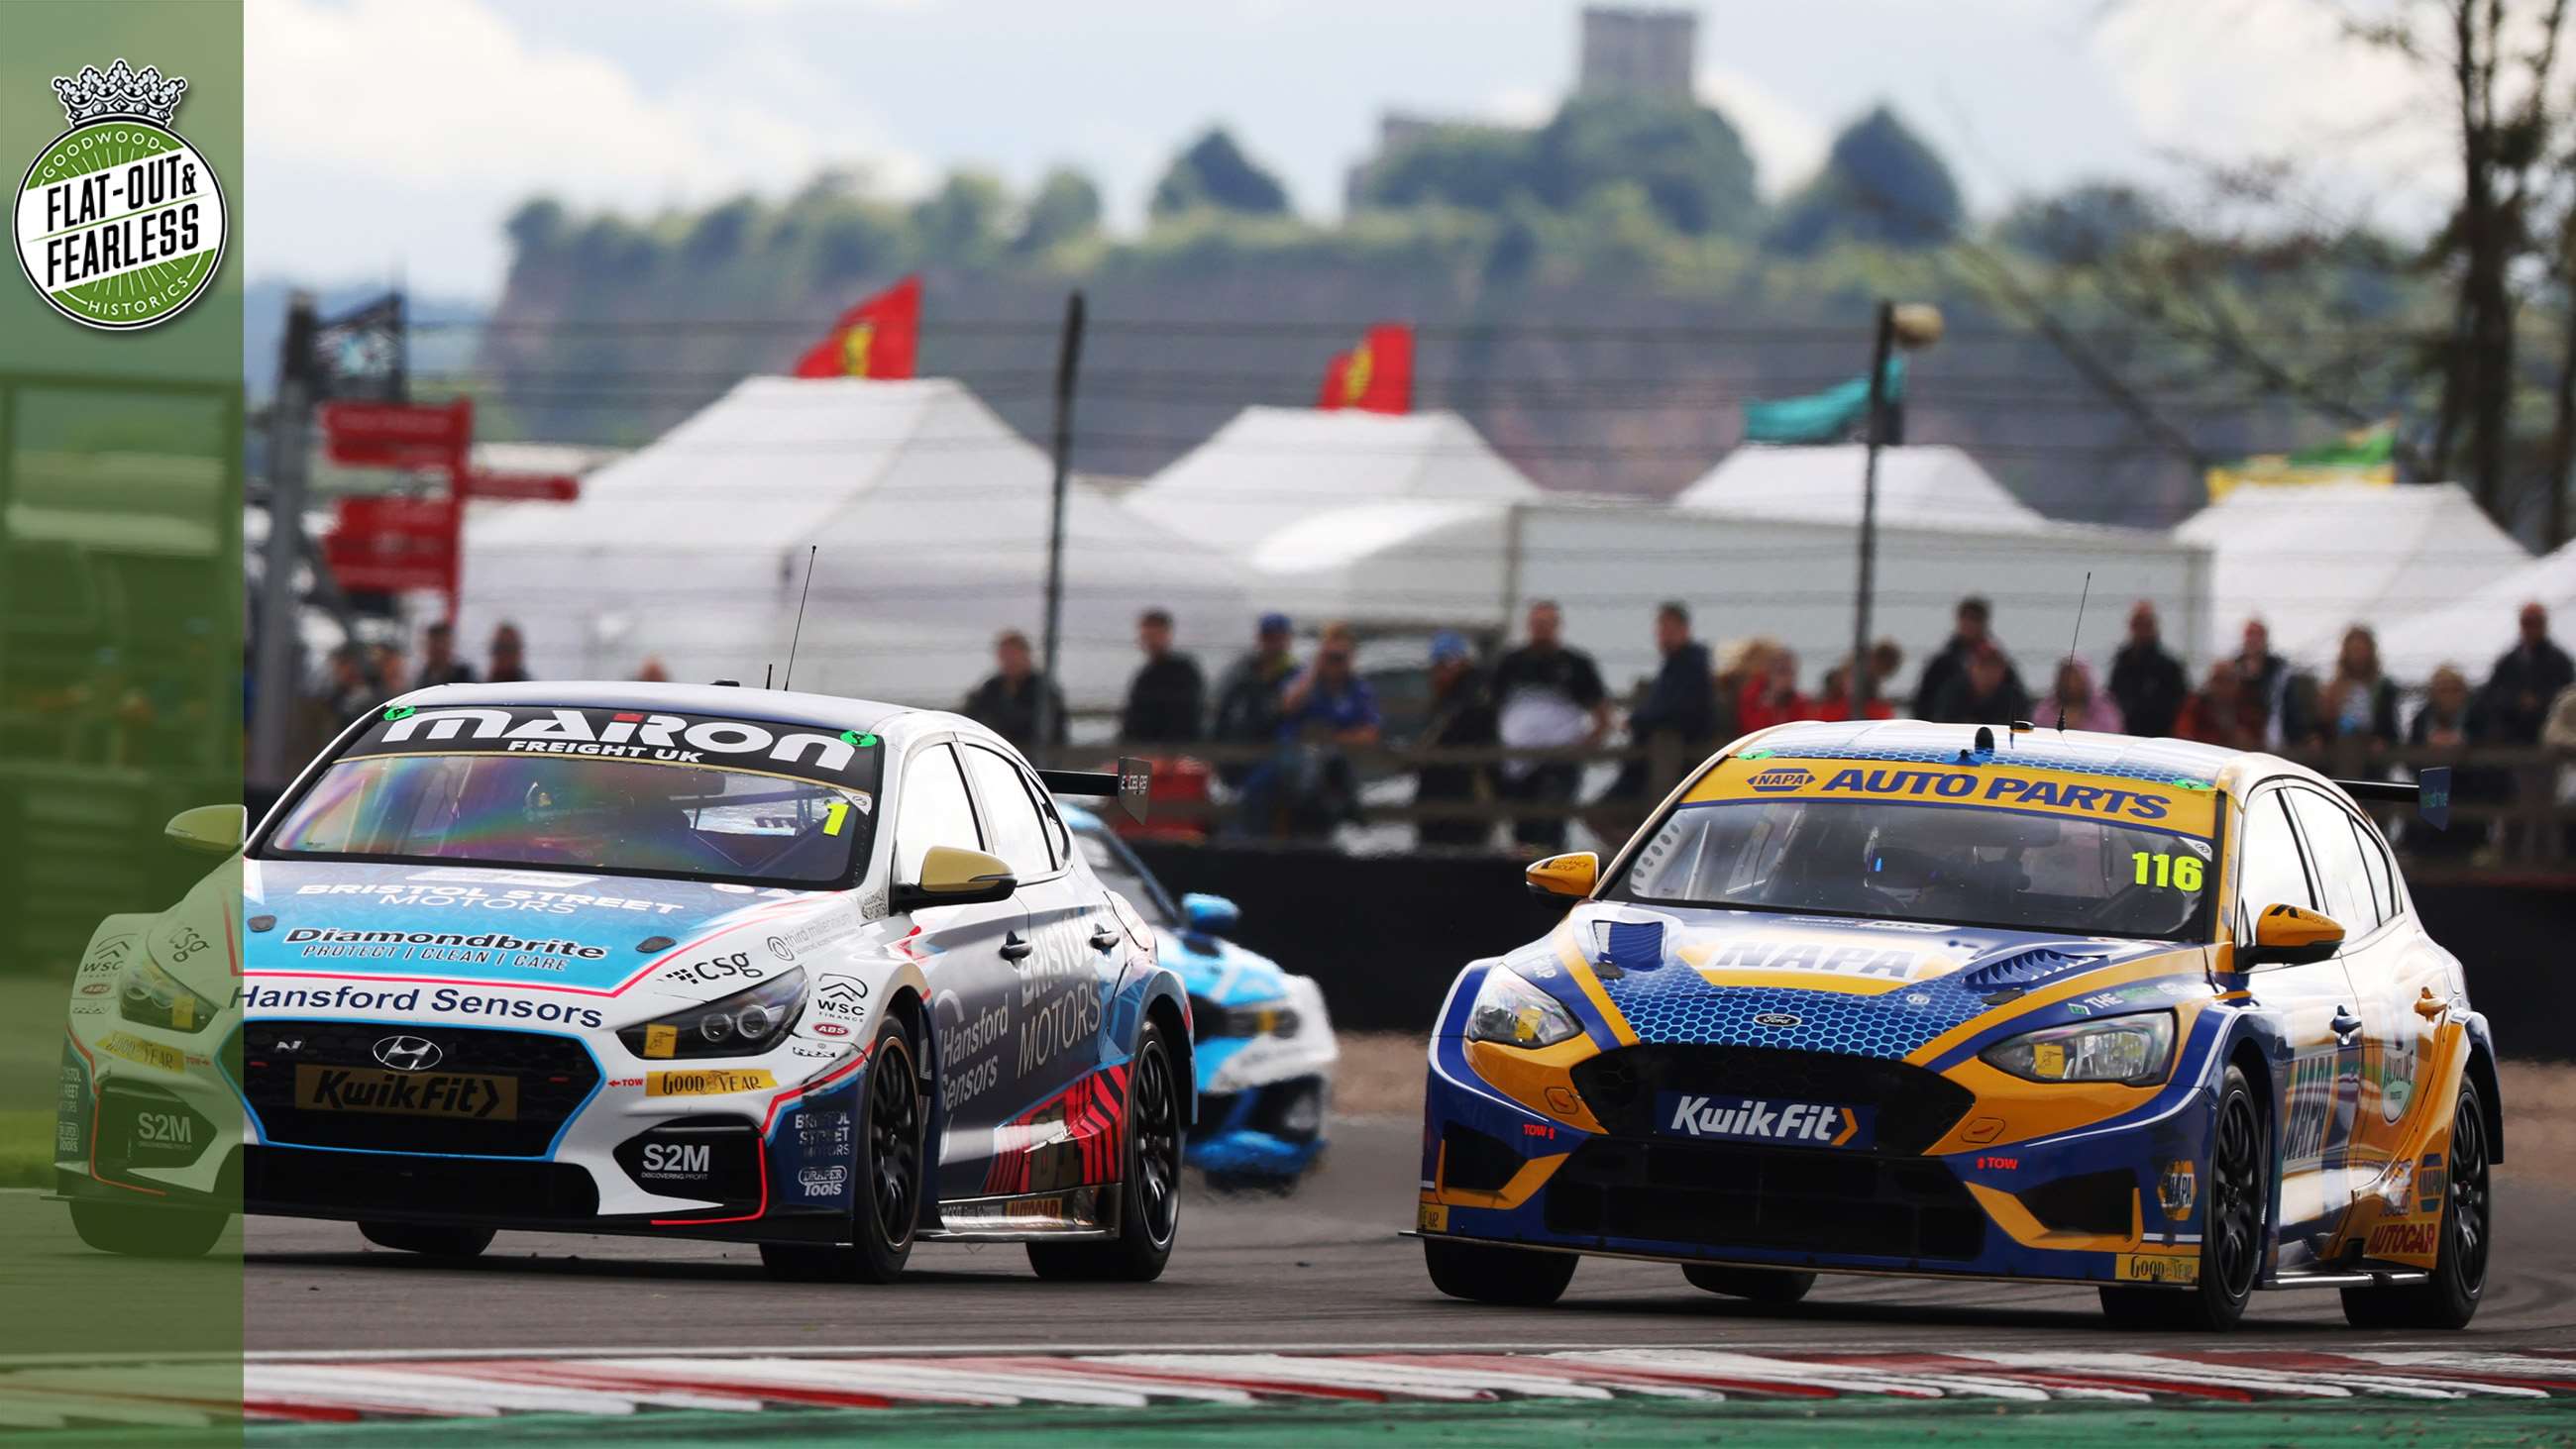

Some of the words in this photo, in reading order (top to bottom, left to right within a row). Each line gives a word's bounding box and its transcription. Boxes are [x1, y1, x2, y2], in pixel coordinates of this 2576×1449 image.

[507, 740, 644, 759] FREIGHT
[654, 749, 704, 764] UK
[1757, 774, 1807, 786] NAPA
[1820, 768, 1979, 797] AUTO
[1982, 776, 2173, 820] PARTS
[822, 800, 850, 837] 1
[2131, 851, 2203, 892] 116
[296, 883, 484, 897] BRISTOL
[505, 888, 685, 914] STREET
[379, 893, 579, 914] MOTORS
[284, 926, 607, 960] Diamondbrite
[82, 960, 124, 973] WSC
[301, 944, 397, 960] PROTECT
[419, 947, 490, 965] CLEAN
[513, 953, 571, 972] CARE
[1716, 942, 1916, 979] NAPA
[229, 984, 417, 1012] Hansford
[431, 987, 603, 1029] Sensors
[817, 998, 865, 1016] WSC
[2084, 991, 2125, 1009] THE
[817, 1024, 846, 1035] ABS
[942, 992, 1009, 1068] Hansford
[1017, 973, 1102, 1079] MOTORS
[1763, 1014, 1792, 1024] Ford
[621, 1078, 644, 1087] TOW
[137, 1111, 192, 1143] S2M
[1523, 1123, 1547, 1137] TOW
[643, 1143, 710, 1172] S2M
[1987, 1156, 2019, 1170] TOW
[2369, 1222, 2435, 1255] AUTOCAR
